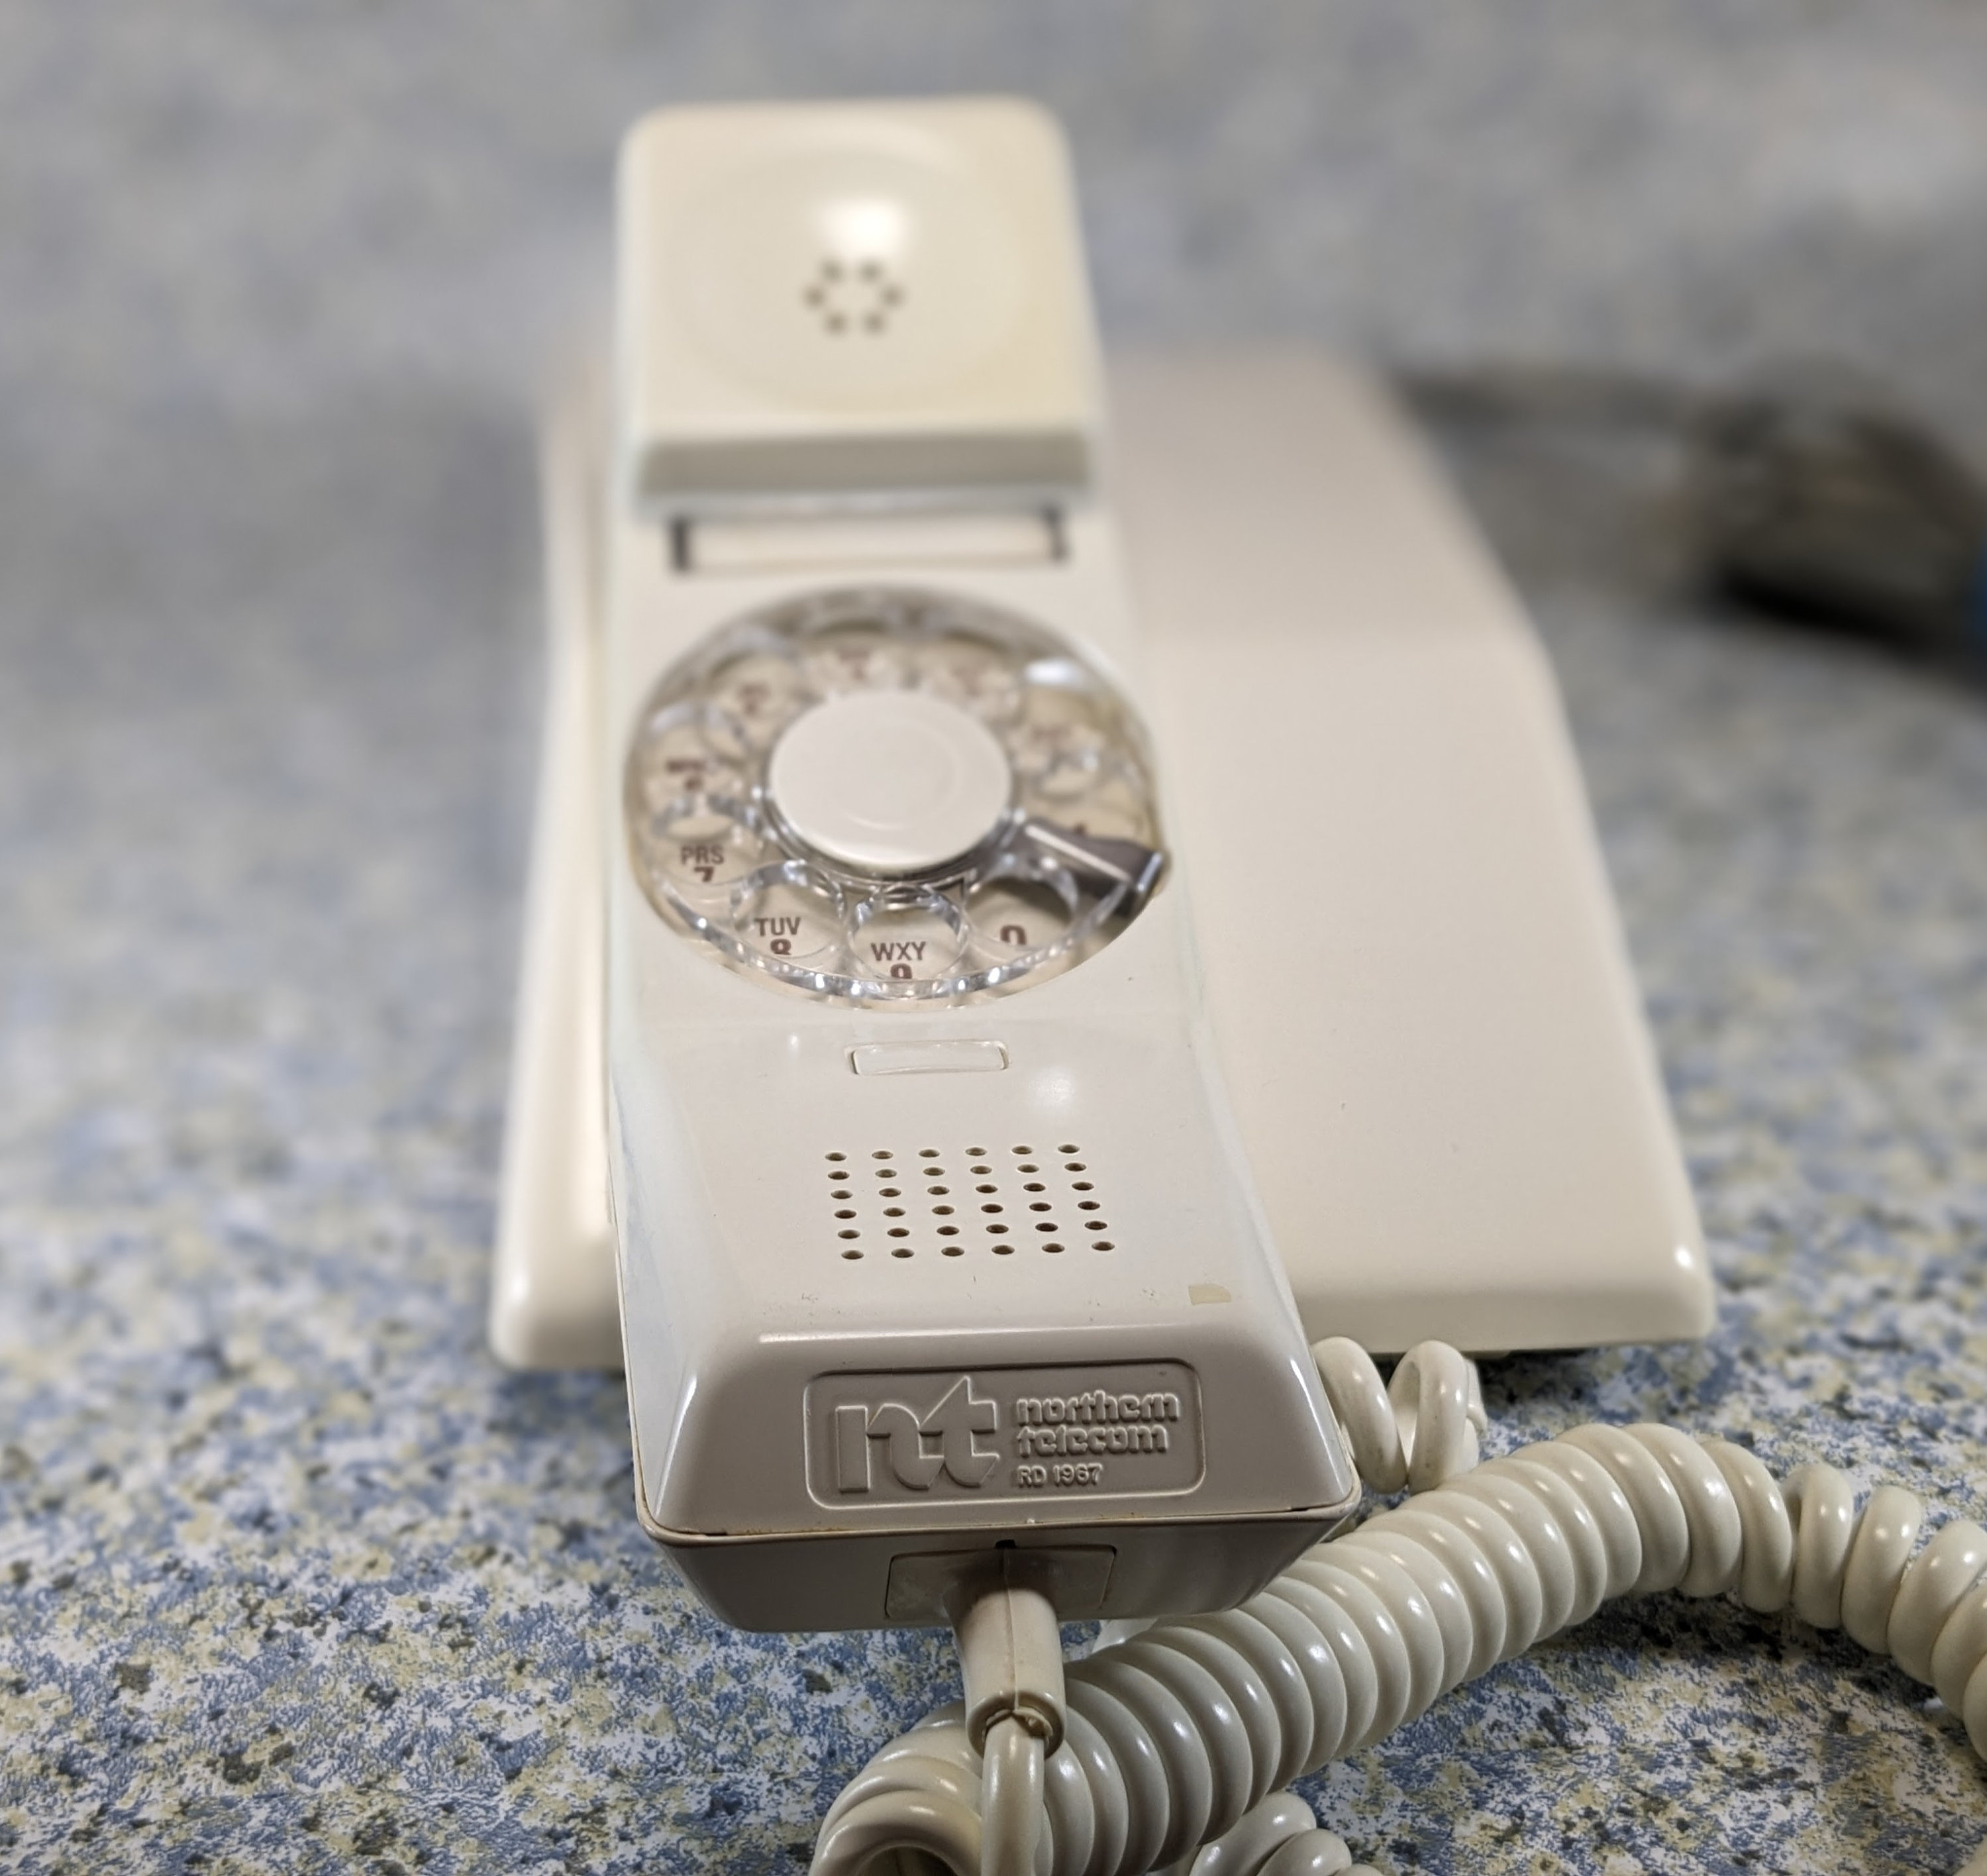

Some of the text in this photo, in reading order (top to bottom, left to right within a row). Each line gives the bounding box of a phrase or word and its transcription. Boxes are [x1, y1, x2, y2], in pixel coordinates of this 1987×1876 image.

[681, 844, 725, 864] PRS
[754, 916, 801, 937] TUV
[871, 941, 927, 961] WXY
[1016, 1389, 1180, 1426] northern
[1016, 1424, 1168, 1457] telecom
[1017, 1463, 1103, 1487] RD 1967
